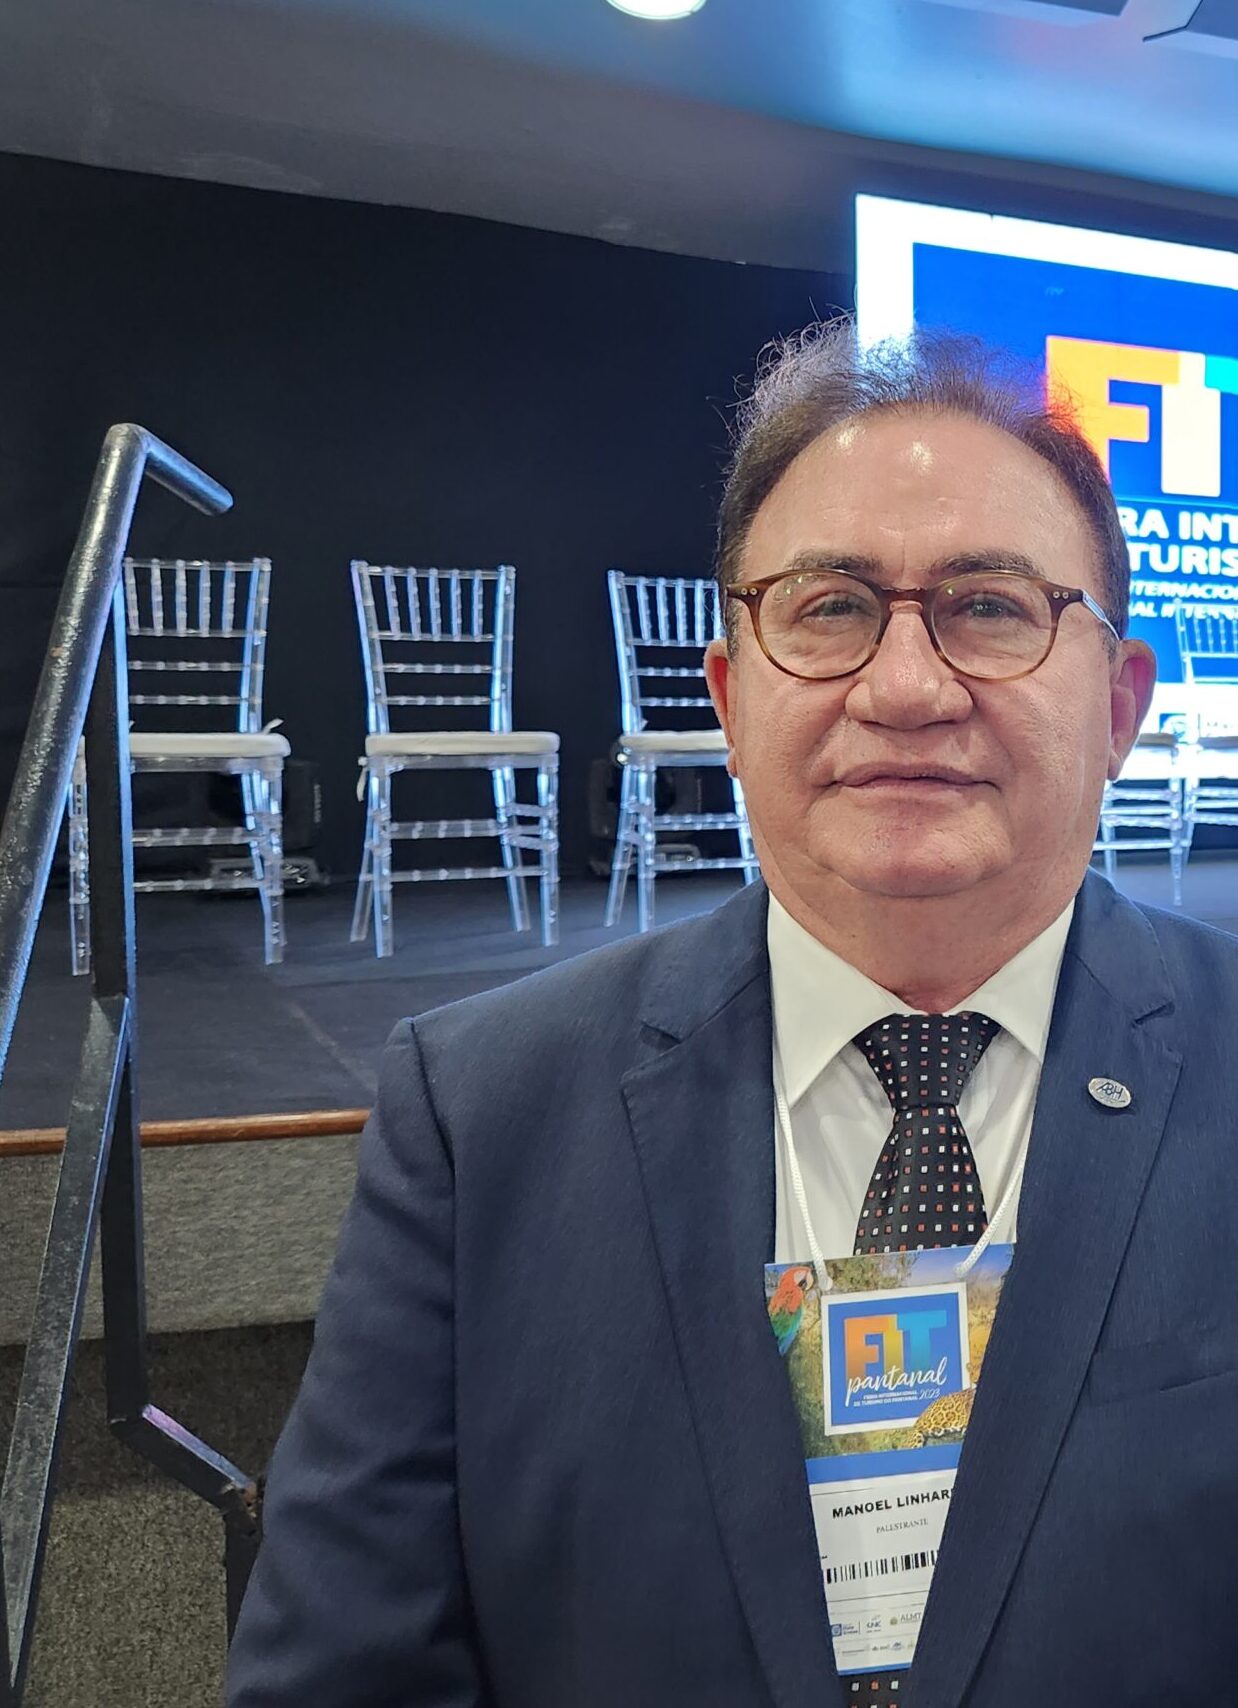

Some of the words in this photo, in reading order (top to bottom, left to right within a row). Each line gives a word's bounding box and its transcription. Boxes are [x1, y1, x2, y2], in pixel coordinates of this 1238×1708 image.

[1116, 506, 1170, 539] RA
[844, 1310, 947, 1386] FIT
[845, 1355, 948, 1407] pantanal
[832, 1499, 893, 1519] MANOEL
[896, 1489, 951, 1508] LINHAR
[876, 1518, 929, 1533] PALESTRANTE
